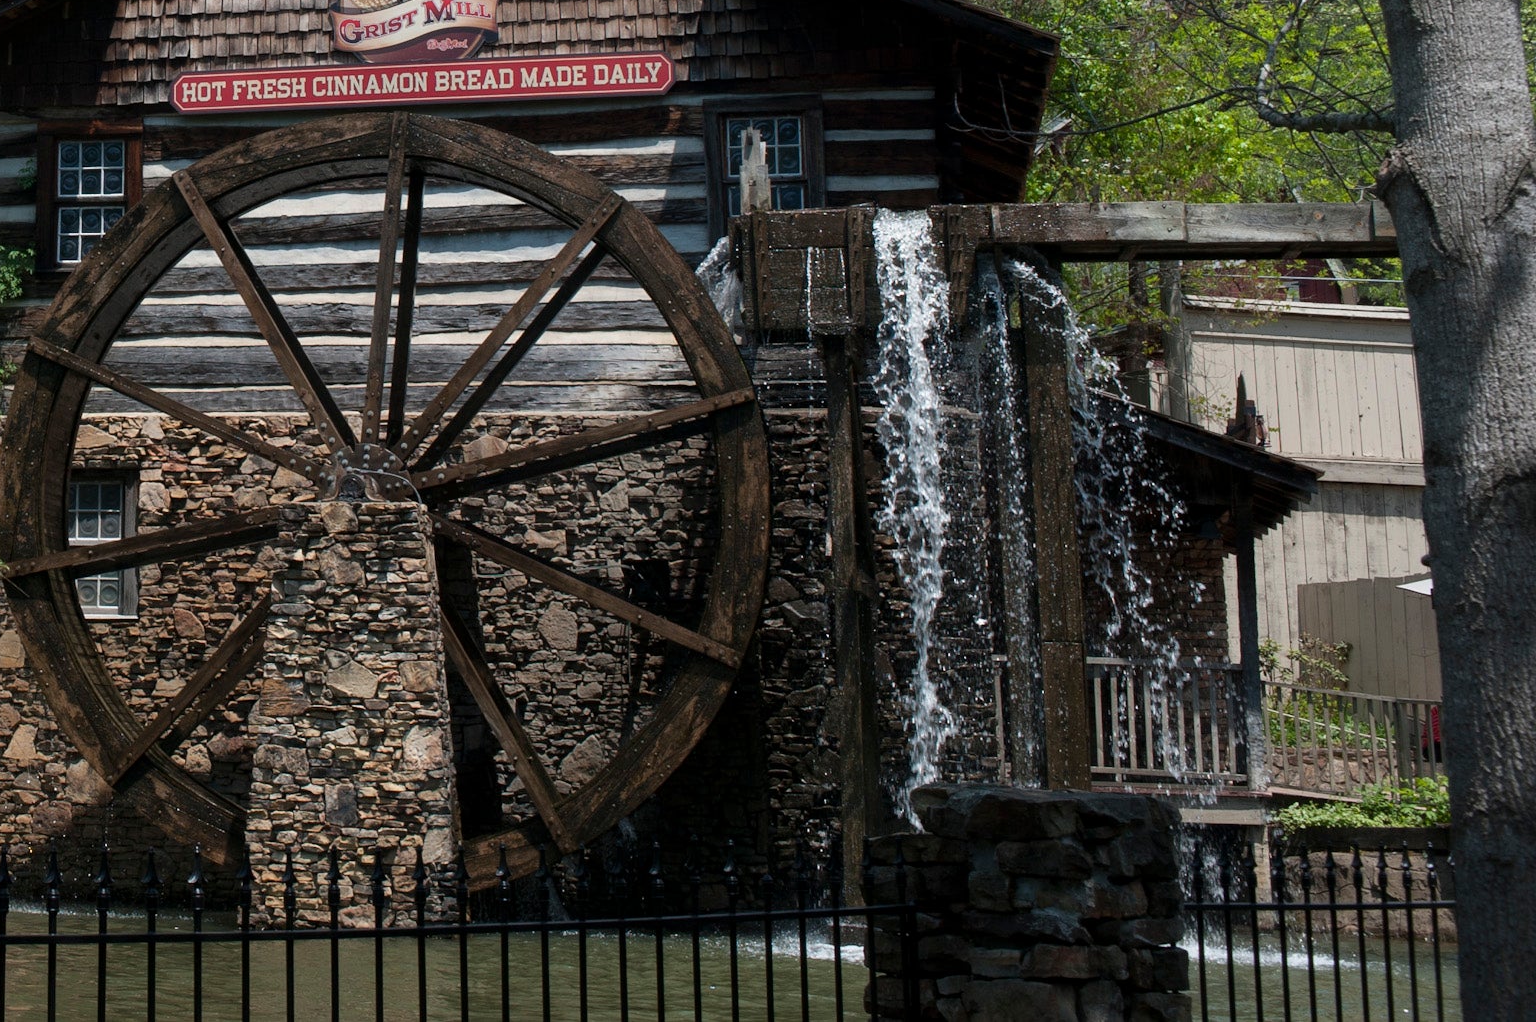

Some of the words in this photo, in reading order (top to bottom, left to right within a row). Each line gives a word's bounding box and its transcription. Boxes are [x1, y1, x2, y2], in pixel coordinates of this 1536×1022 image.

[339, 9, 418, 44] GRIST
[182, 81, 226, 103] HOT
[232, 77, 306, 100] FRESH
[312, 72, 428, 98] CINNAMON
[434, 68, 514, 92] BREAD
[520, 65, 587, 88] MADE
[593, 62, 662, 85] DAILY
